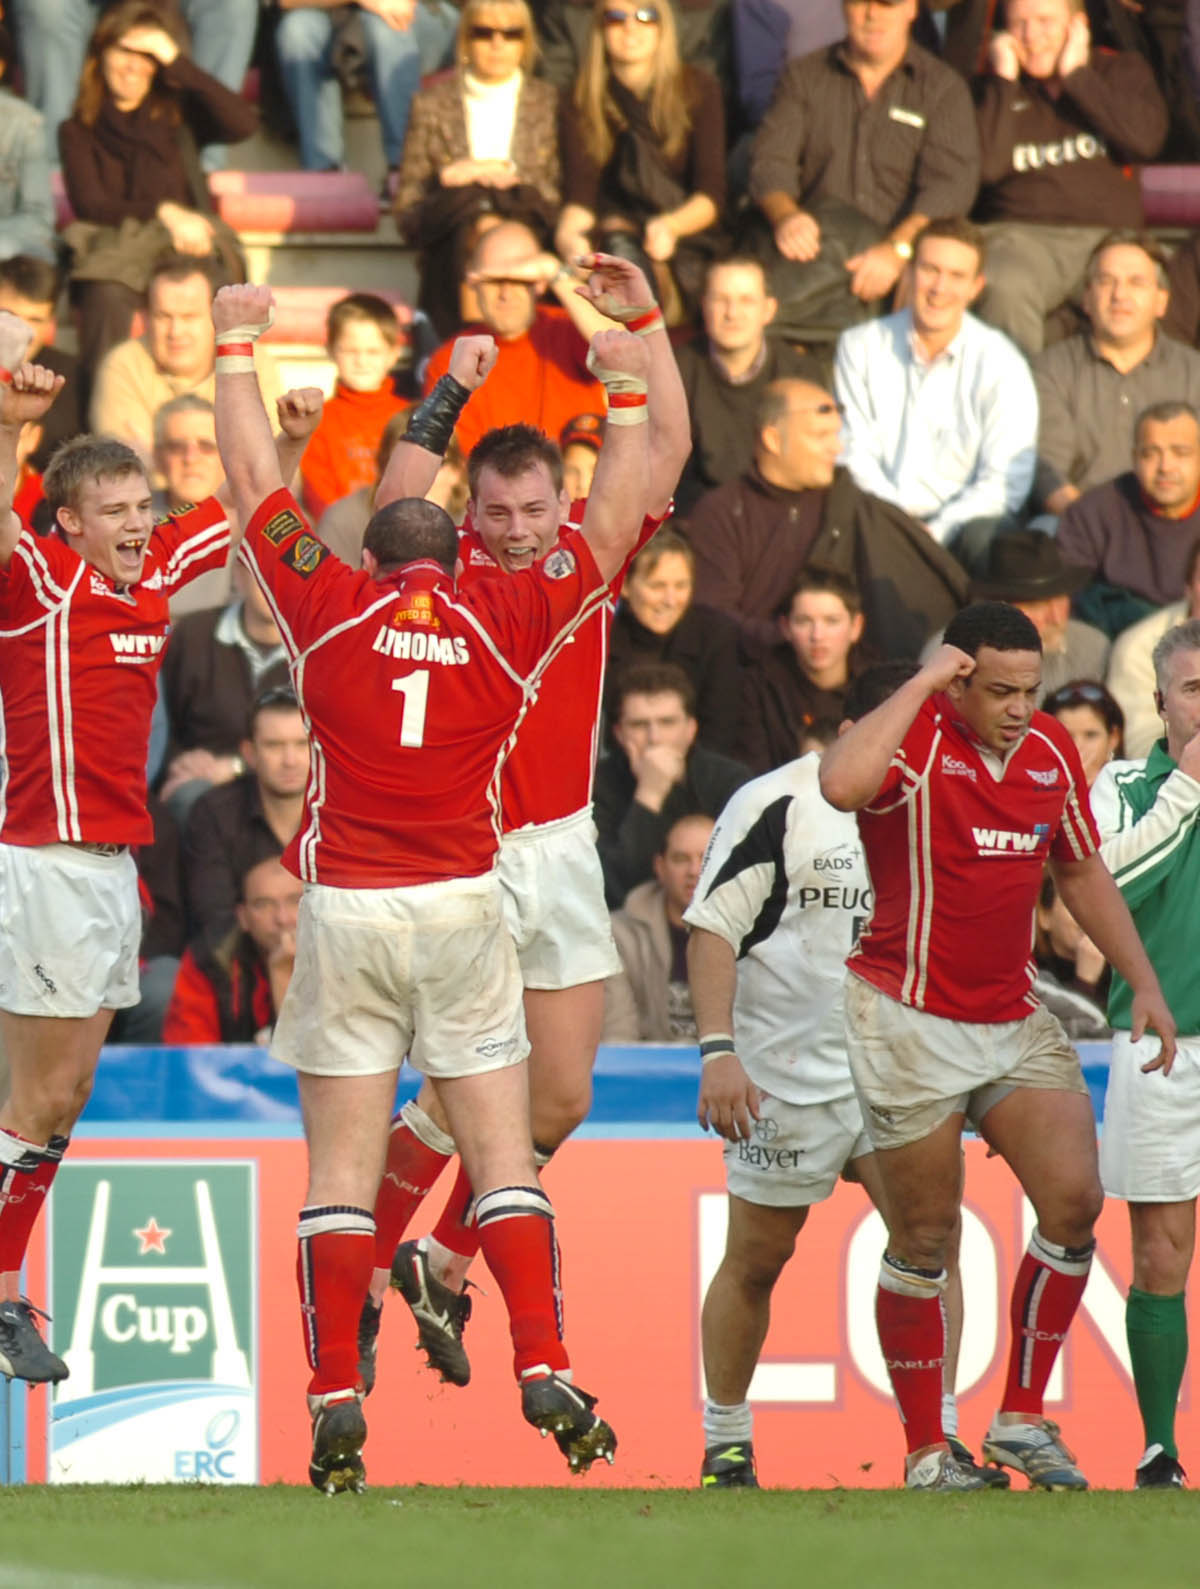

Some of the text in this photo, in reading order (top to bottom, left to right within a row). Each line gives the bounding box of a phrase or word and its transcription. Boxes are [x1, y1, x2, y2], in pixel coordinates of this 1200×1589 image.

[391, 669, 430, 748] 1
[813, 857, 853, 871] EADS
[738, 1139, 805, 1170] Bayer
[698, 1192, 1182, 1403] LO
[101, 1293, 209, 1355] Cup
[173, 1449, 237, 1479] ERC
